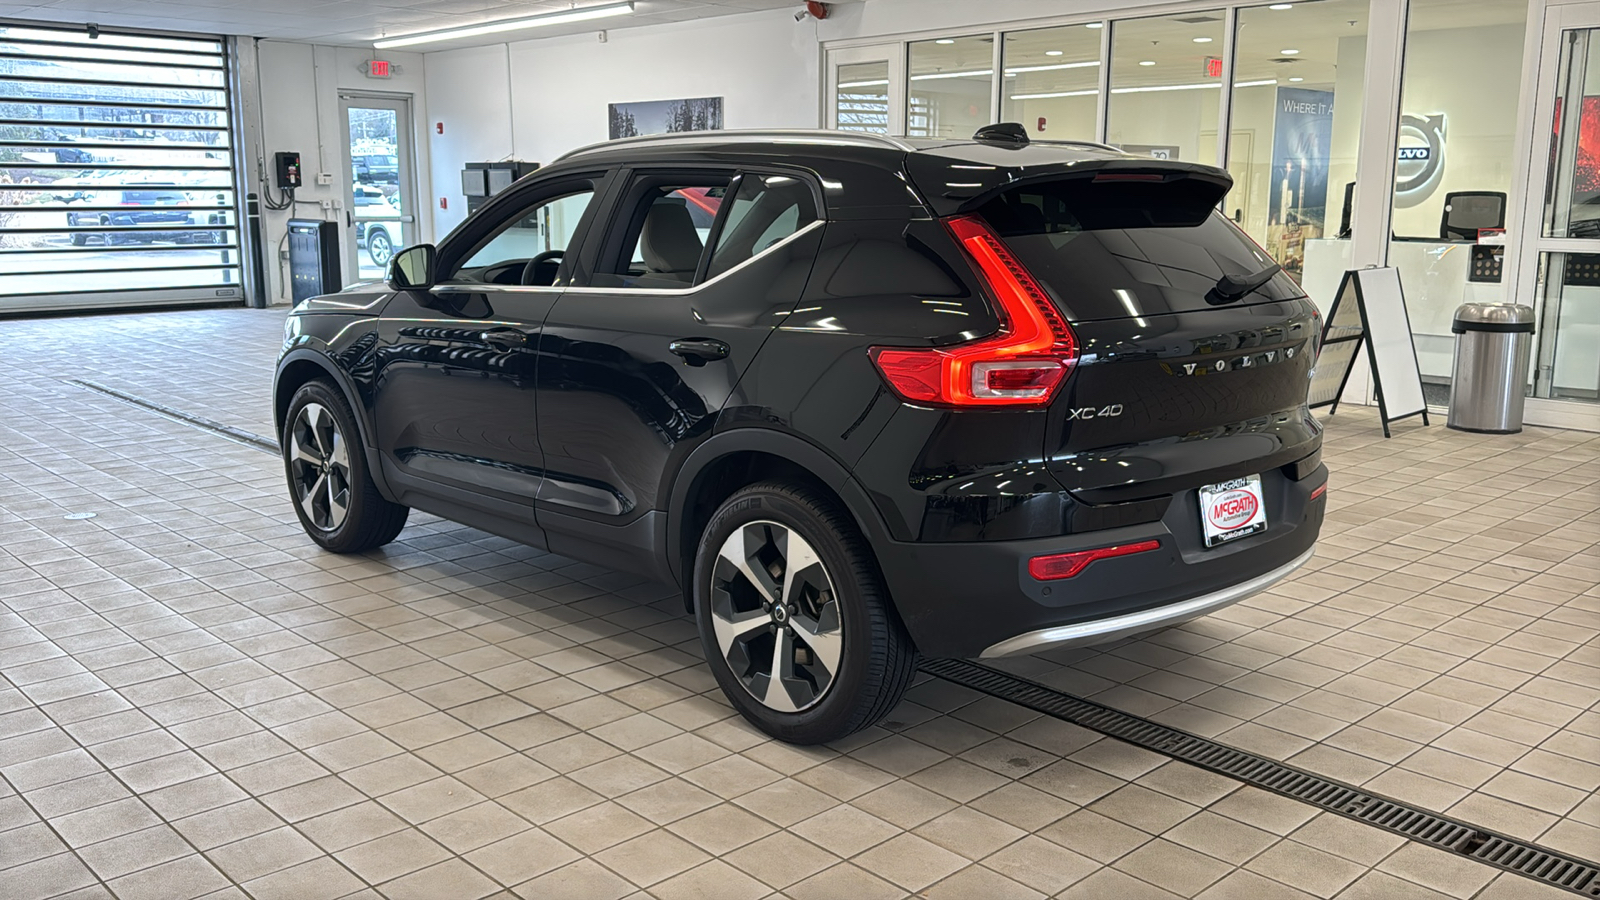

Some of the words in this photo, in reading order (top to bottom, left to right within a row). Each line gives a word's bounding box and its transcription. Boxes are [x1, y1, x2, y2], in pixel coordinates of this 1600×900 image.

[372, 61, 389, 76] EXIT
[1283, 99, 1317, 115] WHERE
[1399, 149, 1428, 159] LVO
[1183, 348, 1294, 376] VOLVO
